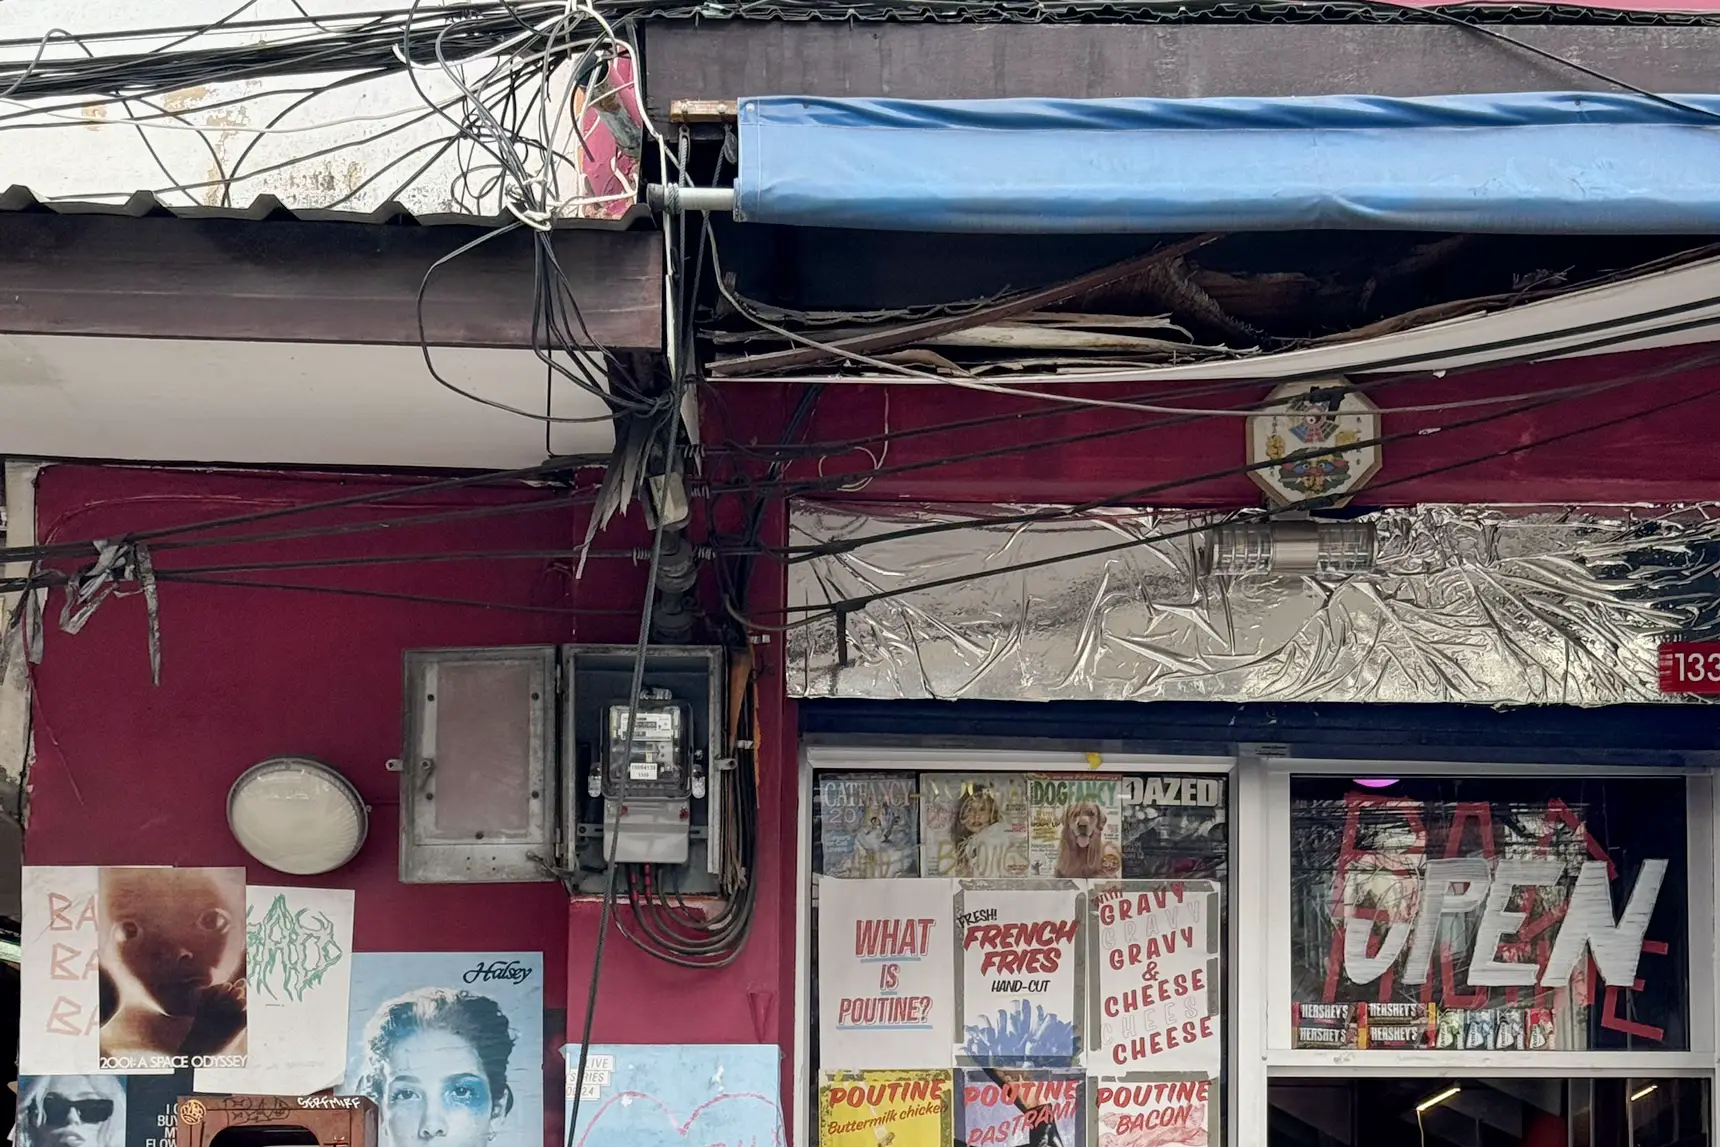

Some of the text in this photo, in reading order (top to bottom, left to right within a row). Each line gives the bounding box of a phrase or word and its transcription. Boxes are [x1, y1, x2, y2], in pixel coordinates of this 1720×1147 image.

[1122, 776, 1219, 808] DAZED
[956, 907, 998, 929] FRESH!
[1099, 881, 1186, 926] GRAVY
[855, 917, 936, 958] WHAT
[963, 919, 1079, 952] FRENCH
[1344, 857, 1670, 988] OPEN
[980, 947, 1062, 977] FRIES
[1108, 926, 1194, 971] GRAVY
[462, 960, 533, 985] Halsey
[880, 962, 900, 990] IS
[990, 978, 1051, 994] HAND-CUT
[1142, 961, 1160, 981] &
[1104, 968, 1206, 1018] CHEESE
[838, 996, 933, 1025] POUTINE?
[1112, 1015, 1214, 1065] CHEESE
[138, 1056, 147, 1068] A
[150, 1055, 189, 1068] SPACE
[191, 1054, 248, 1068] ODYSSEY
[570, 1072, 605, 1083] SRIES
[963, 1078, 1079, 1107] POUTINE
[828, 1078, 947, 1109] POUTINE
[1096, 1079, 1213, 1108] POUTINE
[827, 1101, 949, 1135] Buttermilk chicken
[967, 1101, 1078, 1147] PASTRAMI
[1115, 1105, 1192, 1137] BACON
